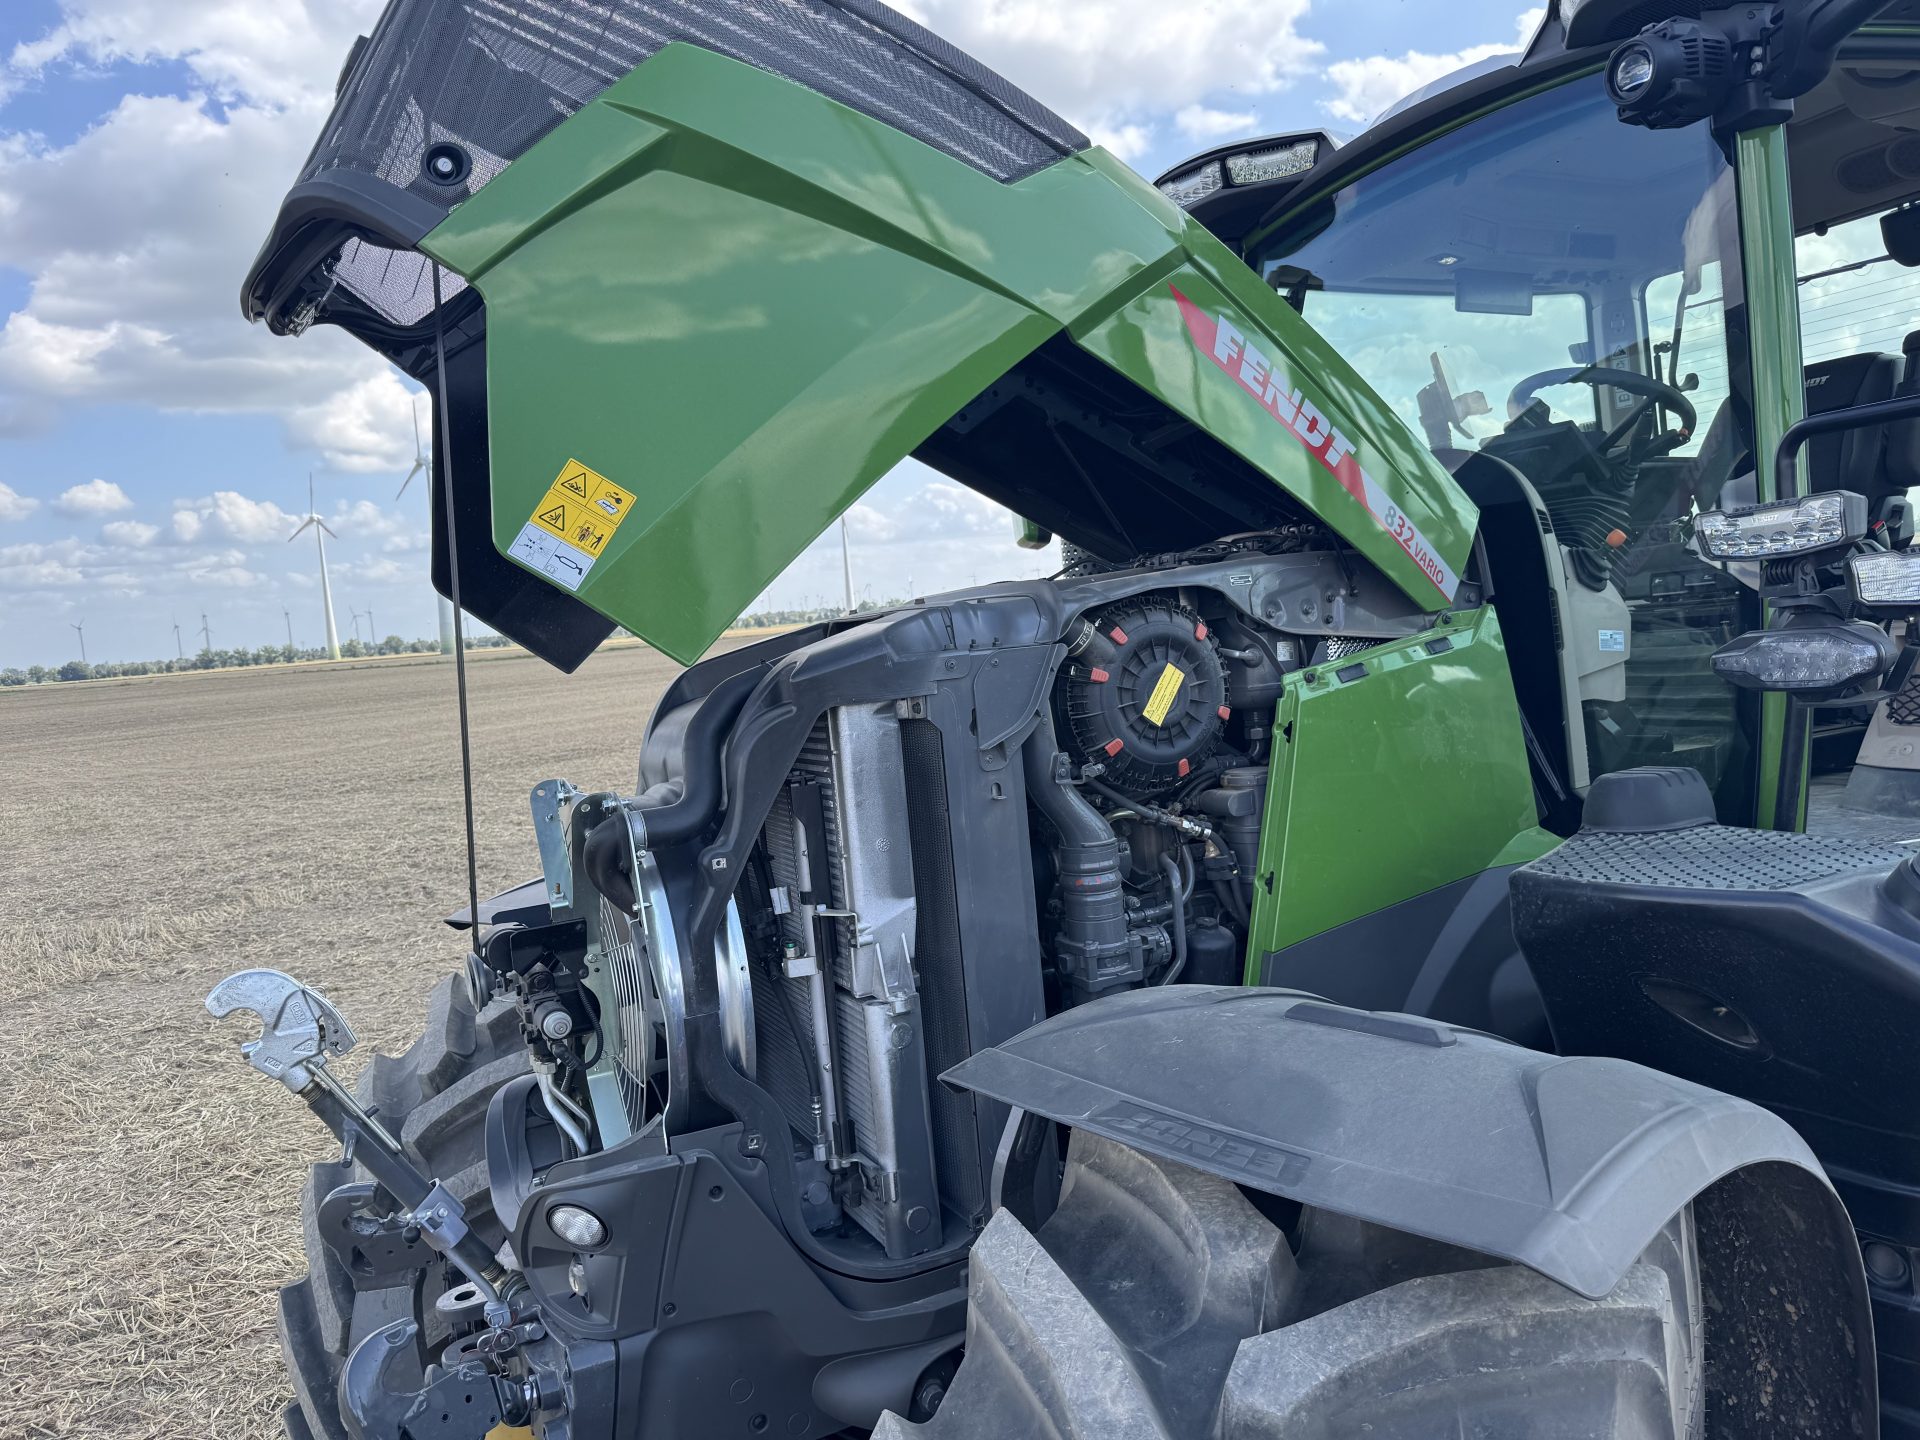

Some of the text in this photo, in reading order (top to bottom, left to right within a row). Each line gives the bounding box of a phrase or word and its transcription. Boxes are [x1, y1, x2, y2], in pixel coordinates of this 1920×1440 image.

[1213, 314, 1356, 467] FENDT
[1385, 505, 1444, 585] 832 VARIO
[1106, 1112, 1286, 1178] FENDT
